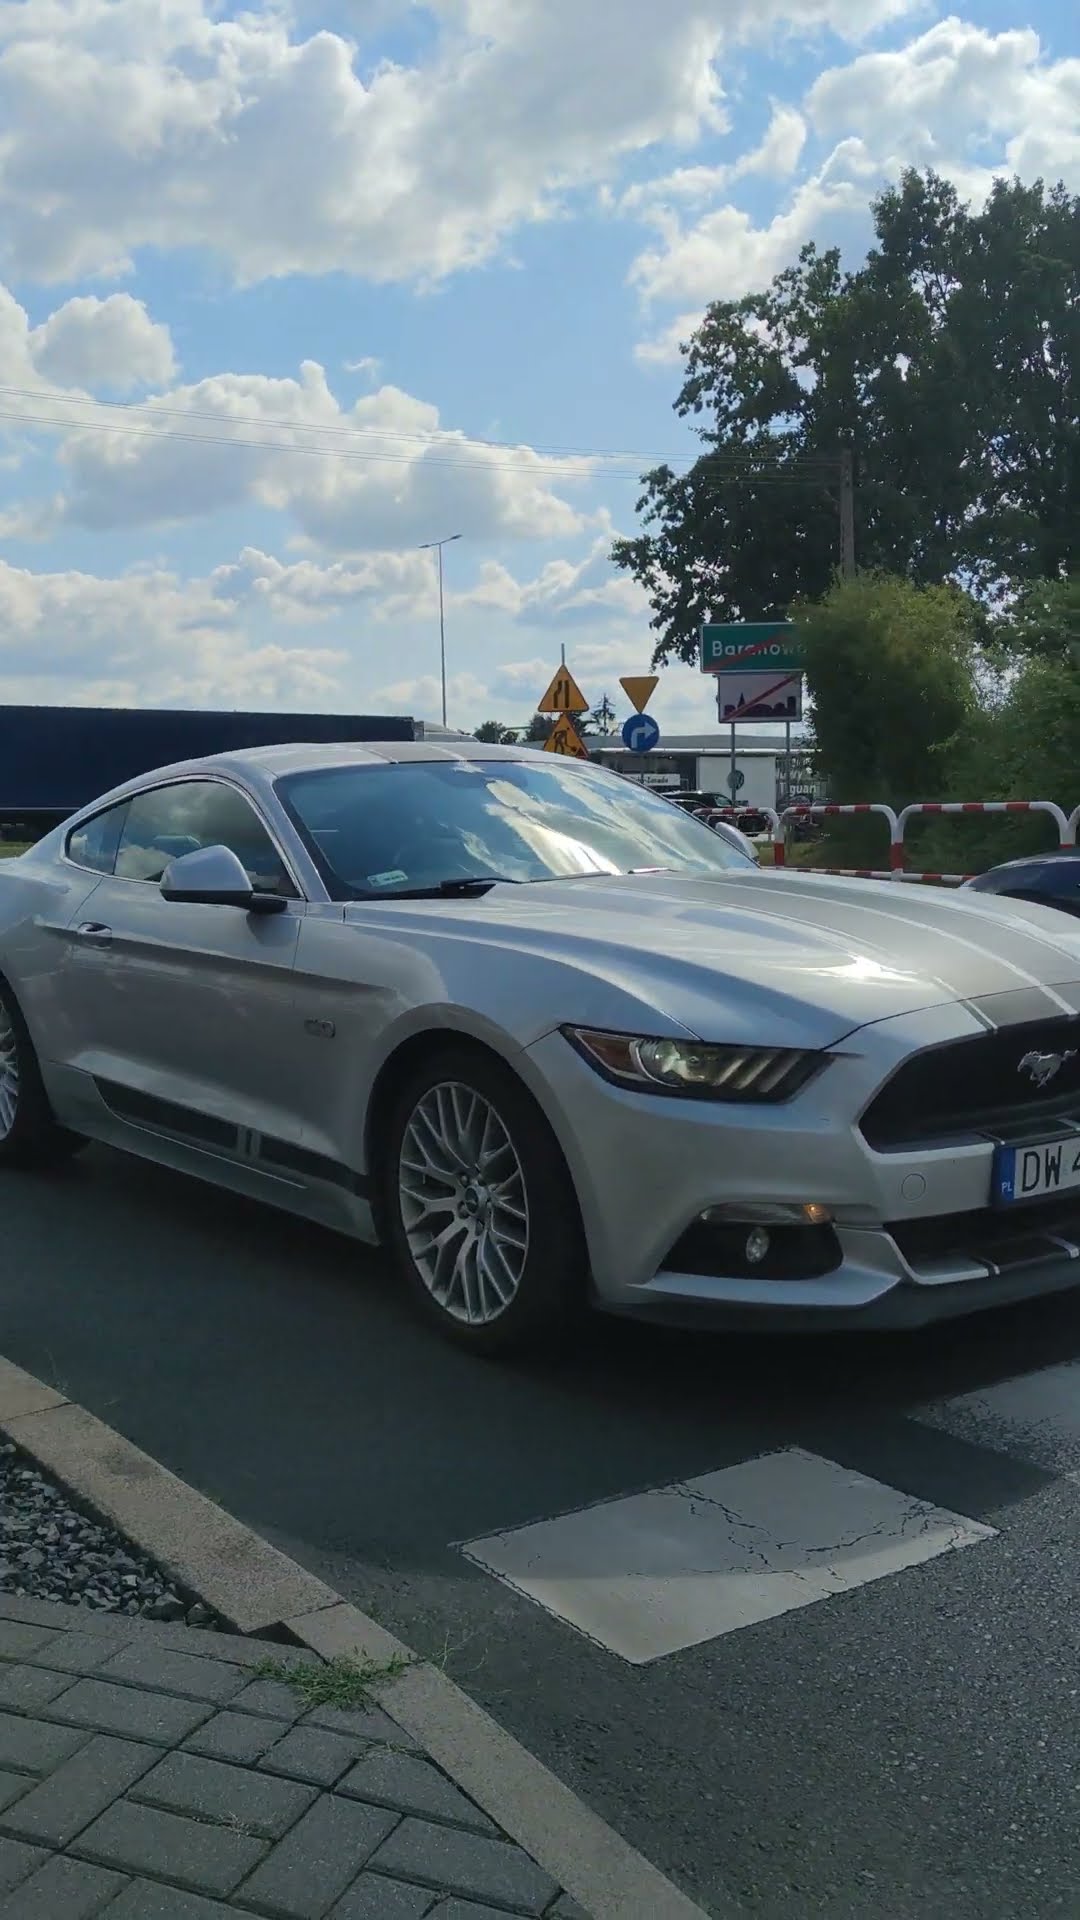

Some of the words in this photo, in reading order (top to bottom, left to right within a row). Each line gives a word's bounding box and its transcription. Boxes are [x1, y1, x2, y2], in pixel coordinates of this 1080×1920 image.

[780, 782, 816, 797] Tguan
[1022, 1145, 1063, 1192] DW
[1001, 1181, 1013, 1192] PL
